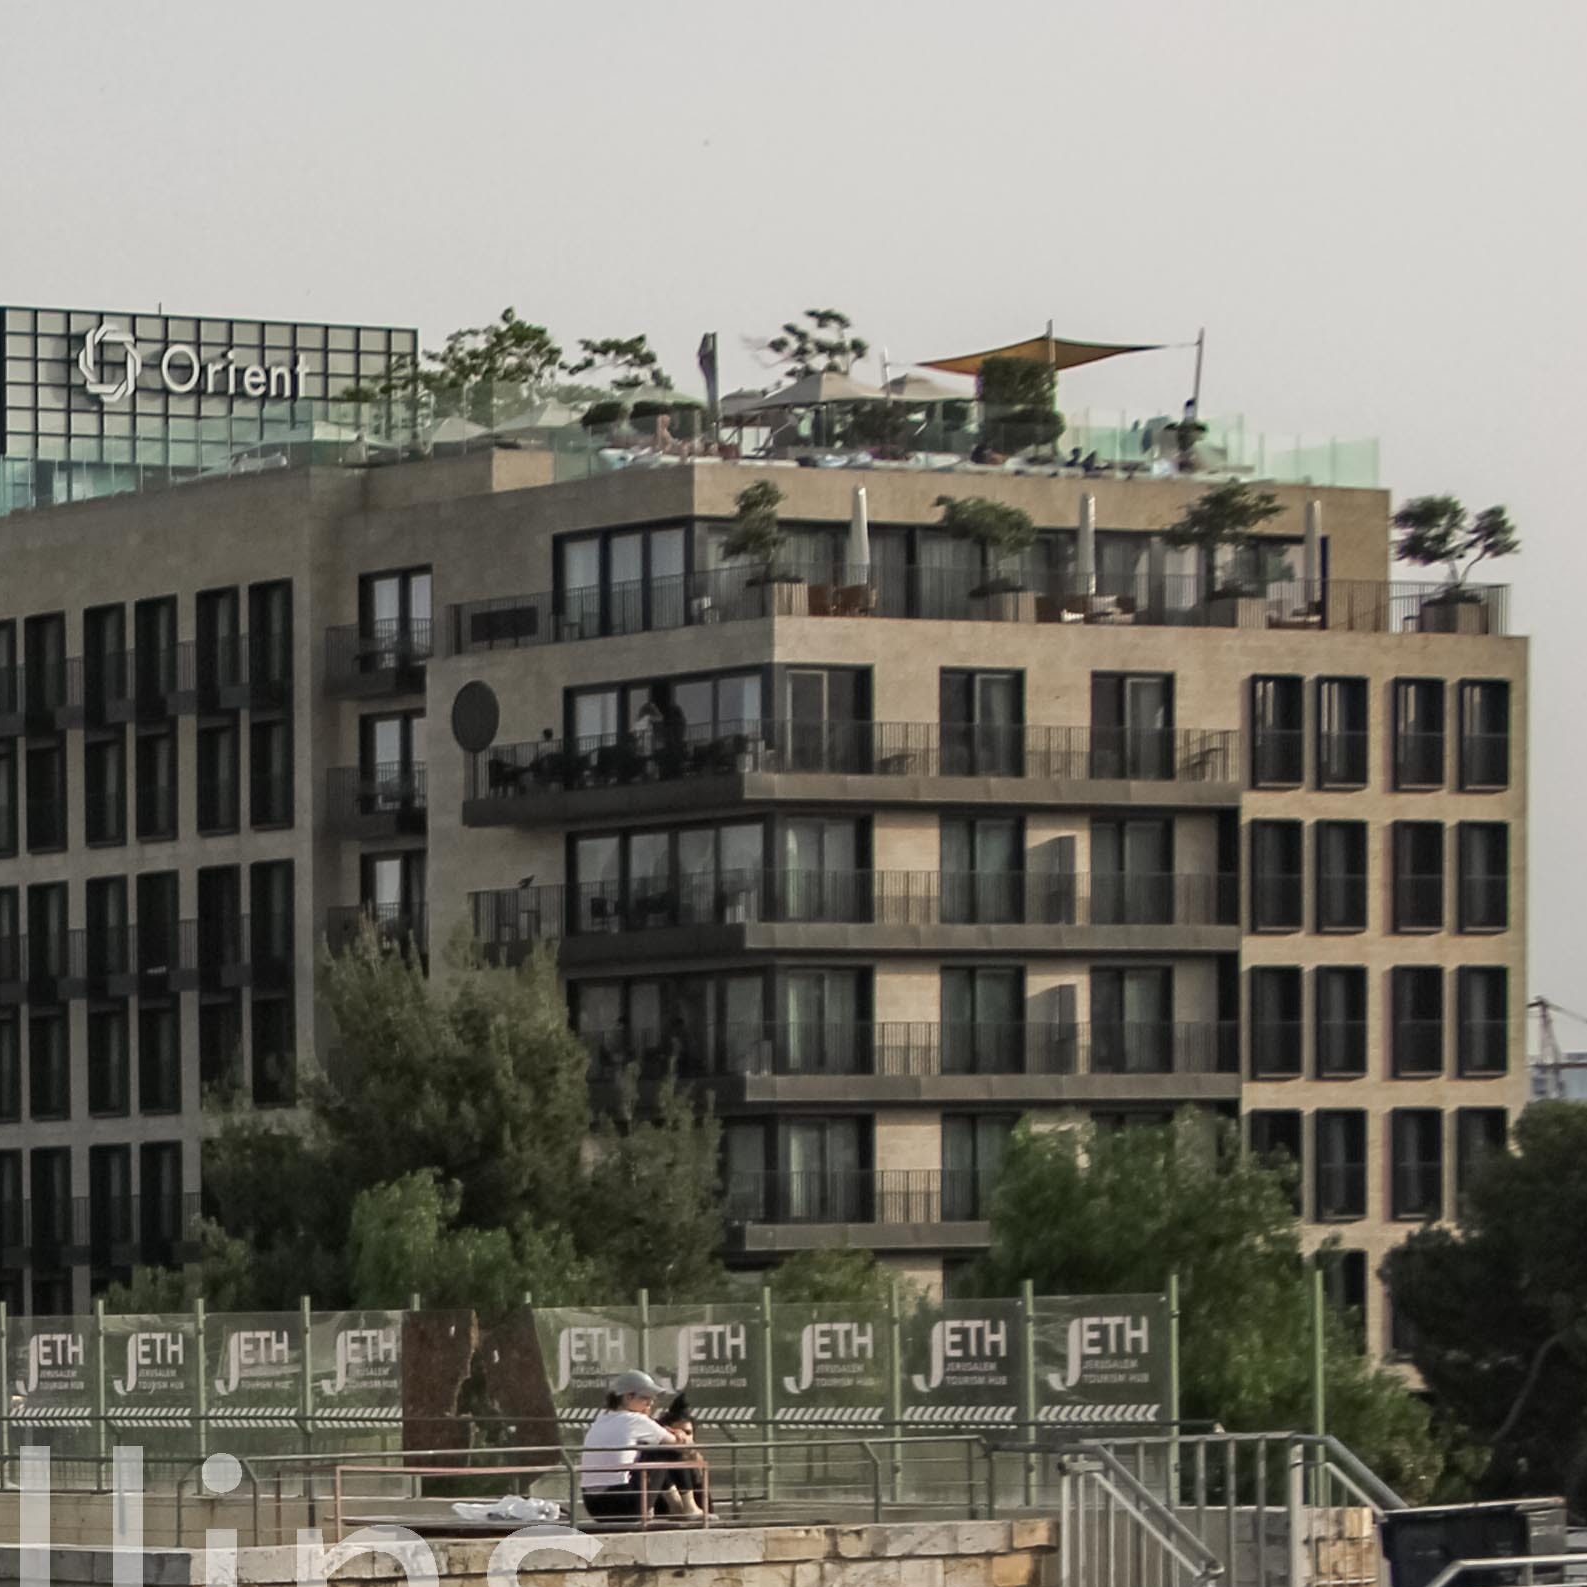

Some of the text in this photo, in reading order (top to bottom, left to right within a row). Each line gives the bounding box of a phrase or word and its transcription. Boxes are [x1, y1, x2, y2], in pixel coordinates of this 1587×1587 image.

[161, 344, 310, 398] Orient
[16, 1334, 84, 1396] JETH
[114, 1332, 184, 1395] JETH
[214, 1330, 288, 1396] JETH
[321, 1329, 396, 1396] JETH
[552, 1327, 625, 1394] JETH
[658, 1324, 746, 1394] JETH
[783, 1322, 873, 1394] JETH
[911, 1320, 1006, 1392] JETH
[946, 1361, 997, 1371] JERUSALEM
[946, 1375, 1007, 1384] TOURISM HUB
[1048, 1316, 1148, 1391] JETH
[1082, 1359, 1138, 1369] JERUSALEM
[1082, 1372, 1149, 1383] TOURISM HUB
